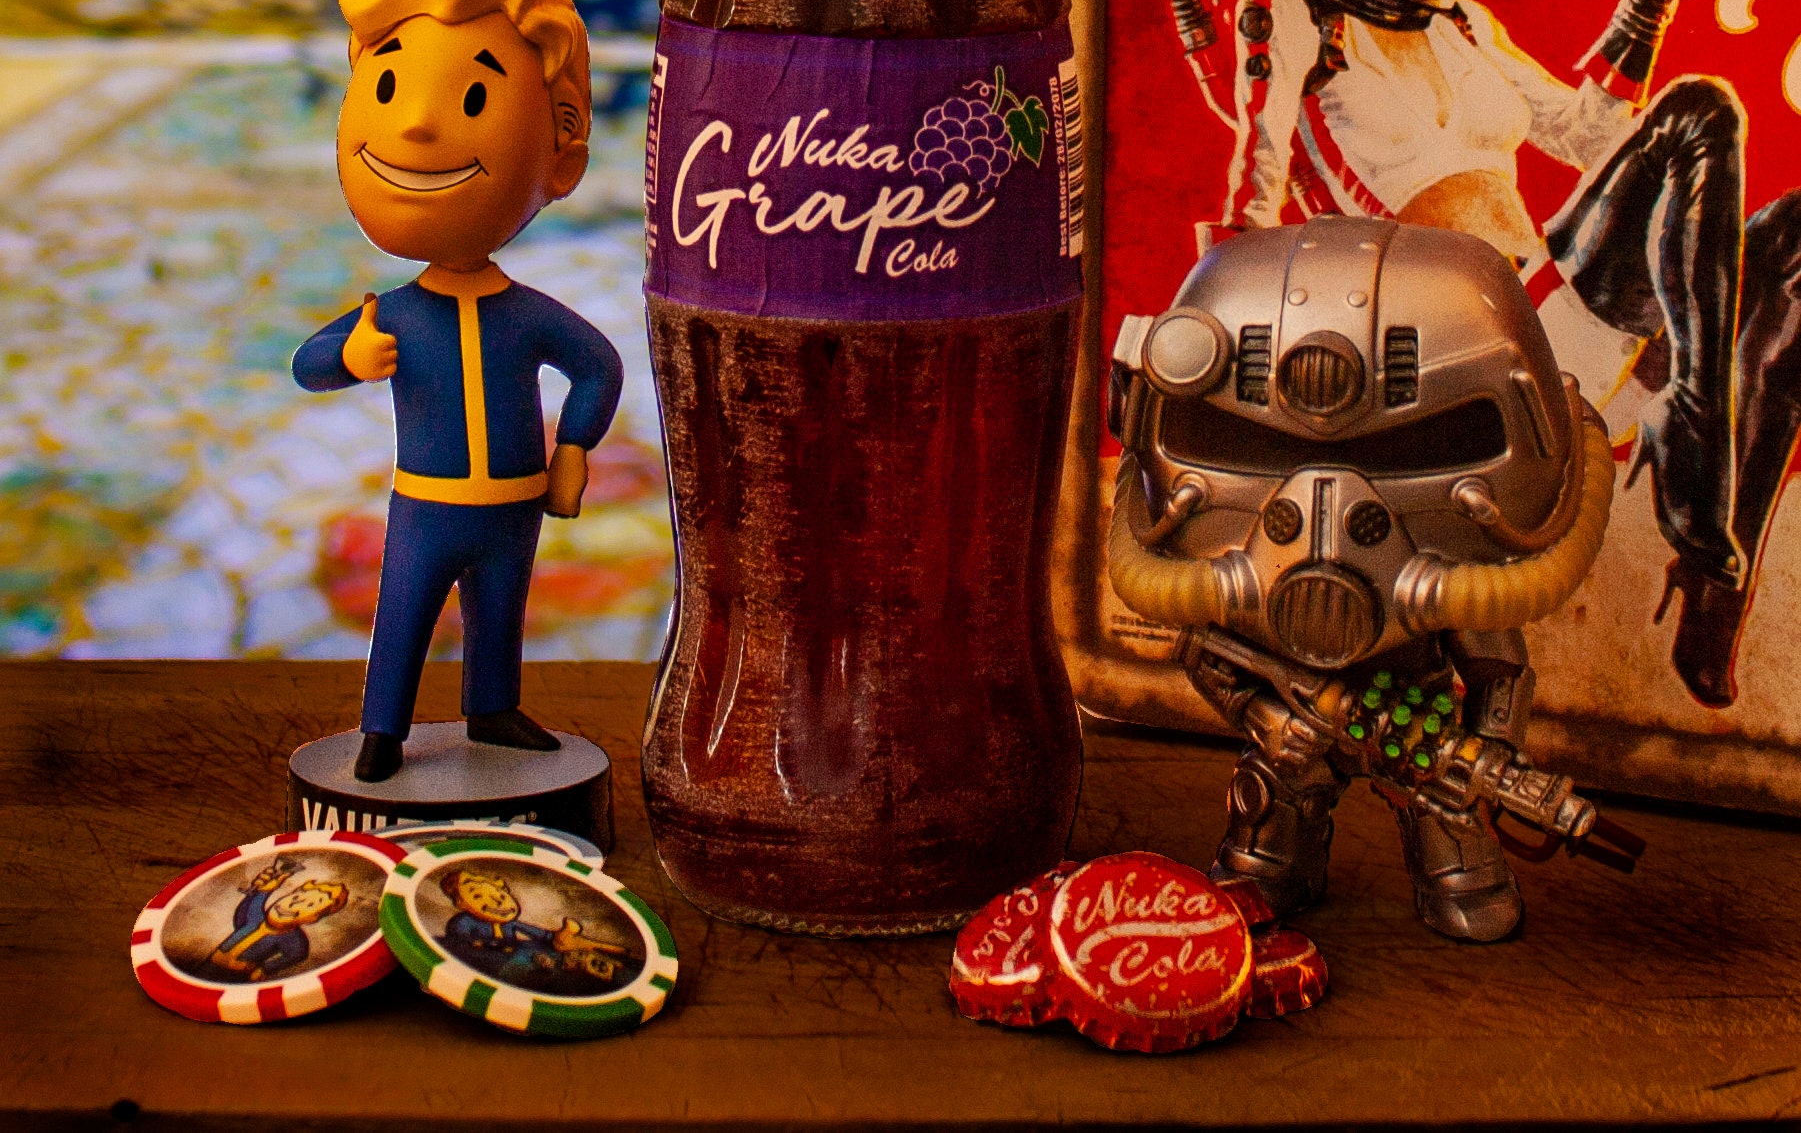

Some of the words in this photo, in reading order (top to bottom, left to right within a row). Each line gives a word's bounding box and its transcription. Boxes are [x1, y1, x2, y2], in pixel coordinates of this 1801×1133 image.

[746, 108, 905, 178] Nuka
[671, 119, 996, 275] Grape
[884, 238, 960, 278] Cola
[1058, 222, 1068, 257] Best
[972, 887, 1039, 962] Cola
[1072, 871, 1218, 933] Nuka
[1109, 938, 1228, 988] Cola
